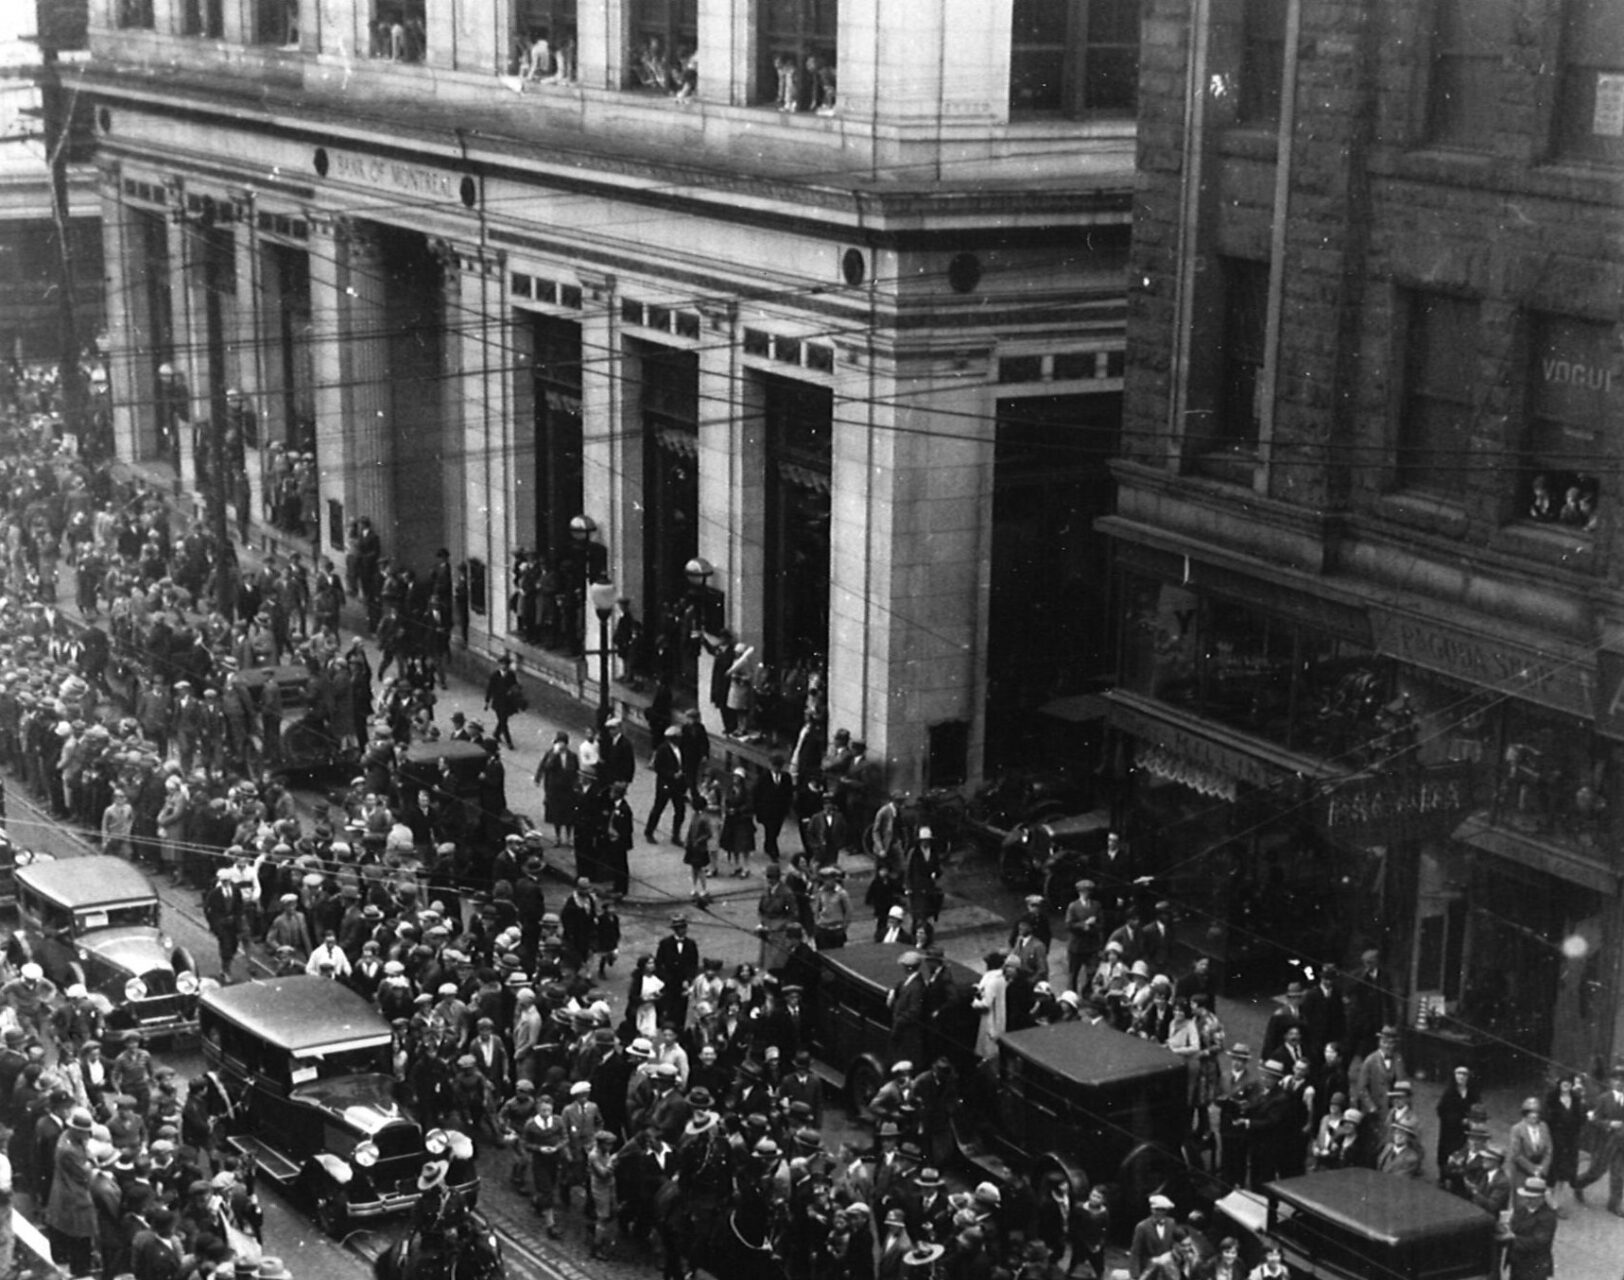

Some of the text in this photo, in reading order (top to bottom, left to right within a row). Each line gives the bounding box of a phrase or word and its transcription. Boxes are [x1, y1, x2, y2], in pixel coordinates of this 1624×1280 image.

[336, 153, 453, 198] BANK OF MONTREAL
